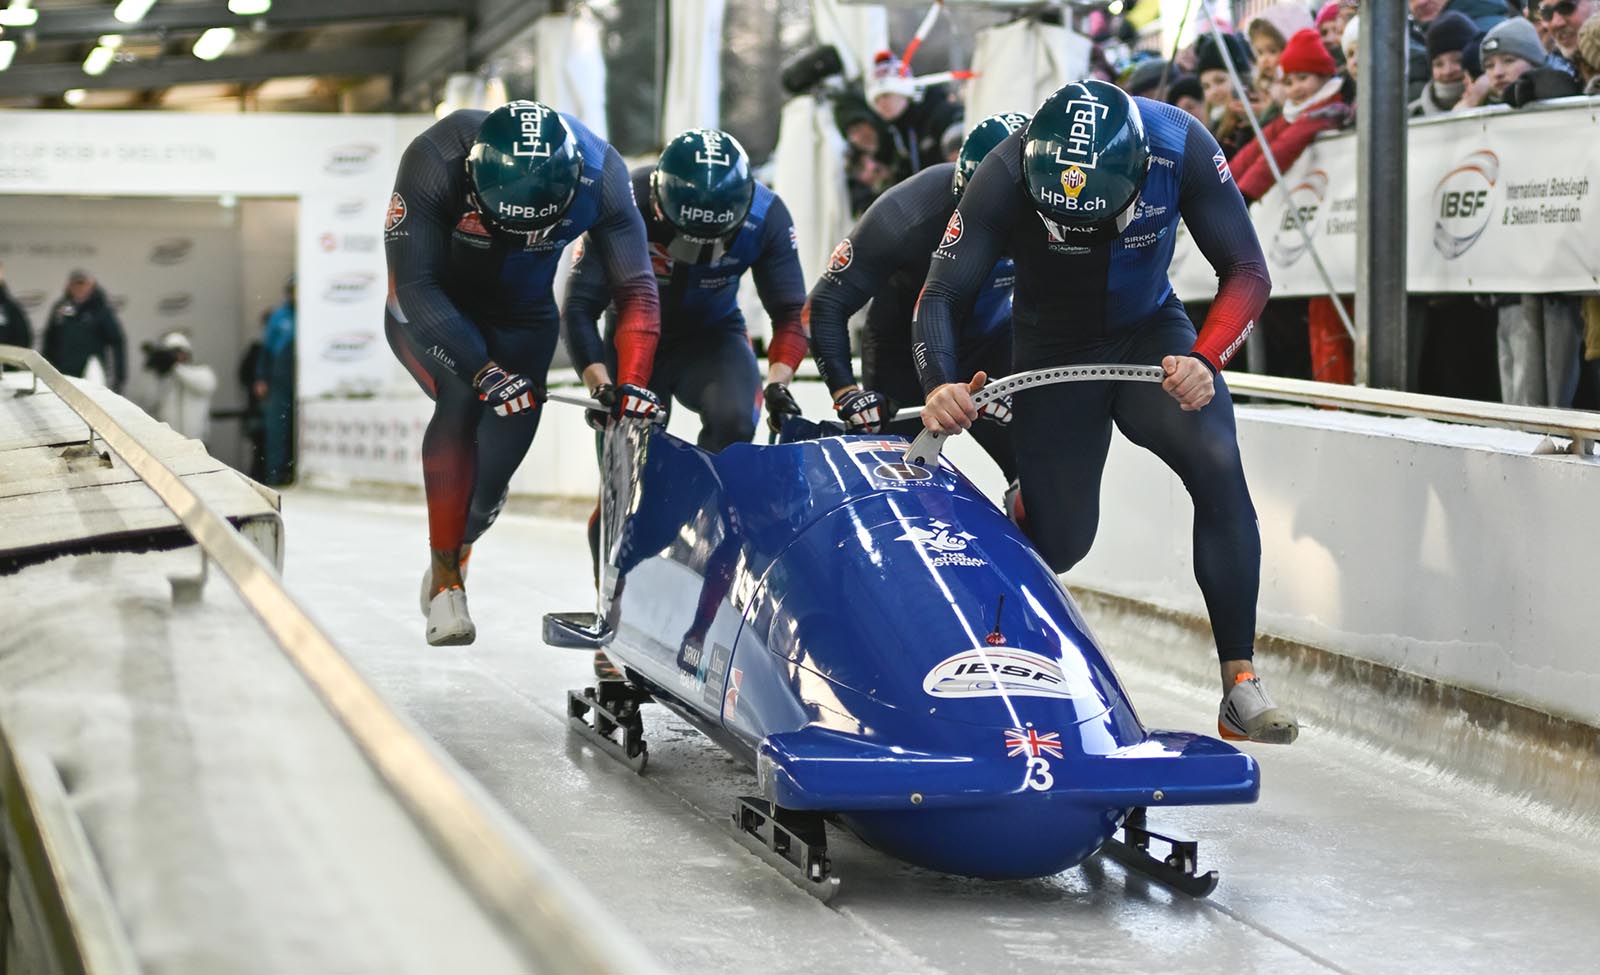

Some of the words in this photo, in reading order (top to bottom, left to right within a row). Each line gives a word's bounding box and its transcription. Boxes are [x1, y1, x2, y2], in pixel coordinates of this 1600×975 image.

[1040, 186, 1107, 211] HPB.ch
[1506, 177, 1549, 200] International
[1549, 176, 1589, 201] Bobsleigh
[499, 201, 558, 219] HPB.ch
[679, 204, 735, 223] HPB.ch
[1440, 190, 1488, 219] IBSF
[1510, 205, 1539, 225] Skeleton
[1540, 202, 1582, 224] Federation
[1124, 232, 1157, 243] SIRKKA
[1124, 237, 1157, 249] HEALTH
[1219, 319, 1255, 365] KEISER
[427, 345, 457, 368] Altus
[499, 378, 527, 400] SEIZ
[852, 393, 878, 412] SEIZ
[954, 663, 1062, 686] IBSF
